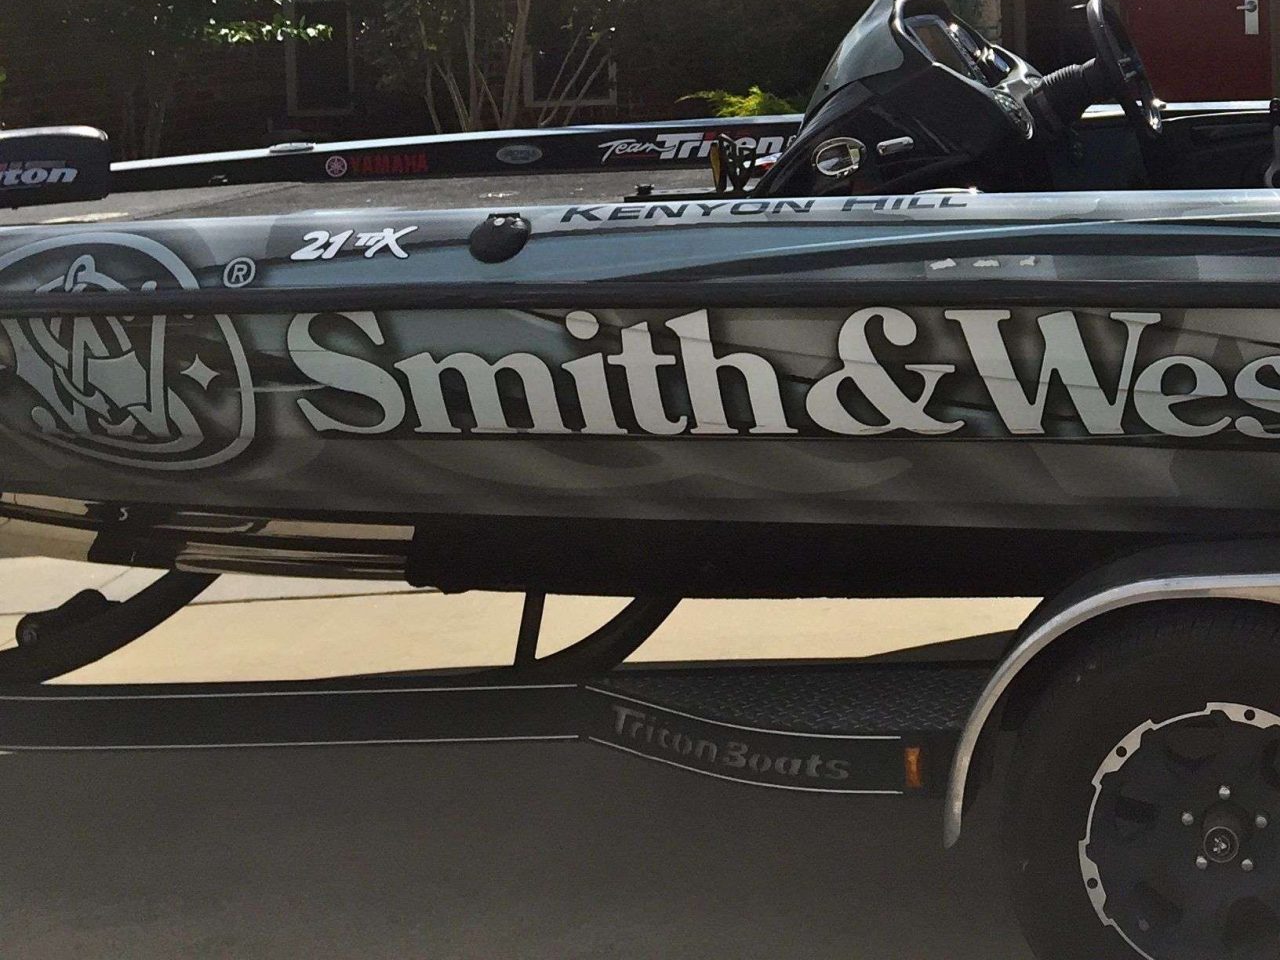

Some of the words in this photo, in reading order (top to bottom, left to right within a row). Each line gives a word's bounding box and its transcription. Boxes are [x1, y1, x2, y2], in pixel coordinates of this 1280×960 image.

[598, 138, 675, 165] Team
[655, 132, 785, 161] Trion
[349, 152, 428, 175] YAMAHA
[559, 197, 816, 224] KENYON
[841, 195, 970, 212] HILL
